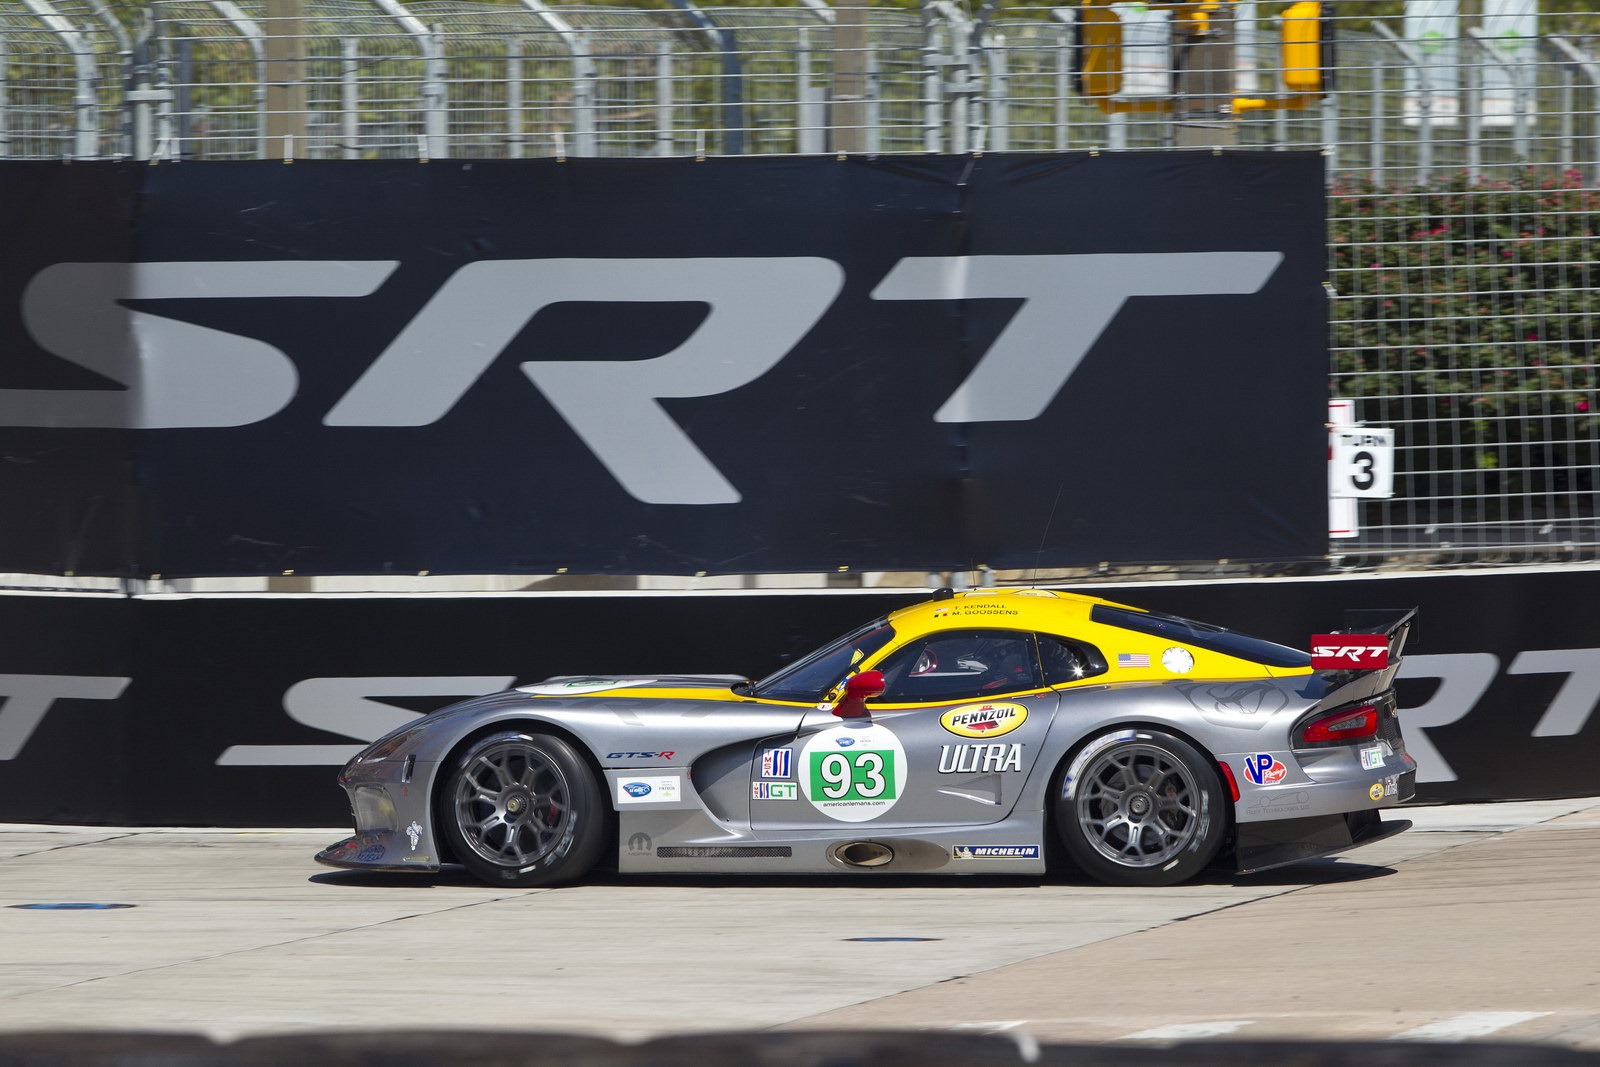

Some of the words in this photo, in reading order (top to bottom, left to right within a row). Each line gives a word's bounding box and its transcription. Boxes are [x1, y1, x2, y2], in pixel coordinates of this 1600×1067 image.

[0, 251, 1283, 505] SRT
[1352, 450, 1375, 491] 3
[1312, 645, 1388, 662] SRT
[951, 707, 1017, 727] PENNZOIL
[605, 750, 676, 761] GTS-R
[937, 743, 1022, 774] ULTRA
[820, 751, 887, 800] 93
[1244, 753, 1274, 785] VP
[770, 784, 796, 797] GT
[822, 800, 886, 808] americanlemans.com
[974, 847, 1036, 856] MICHELIN
